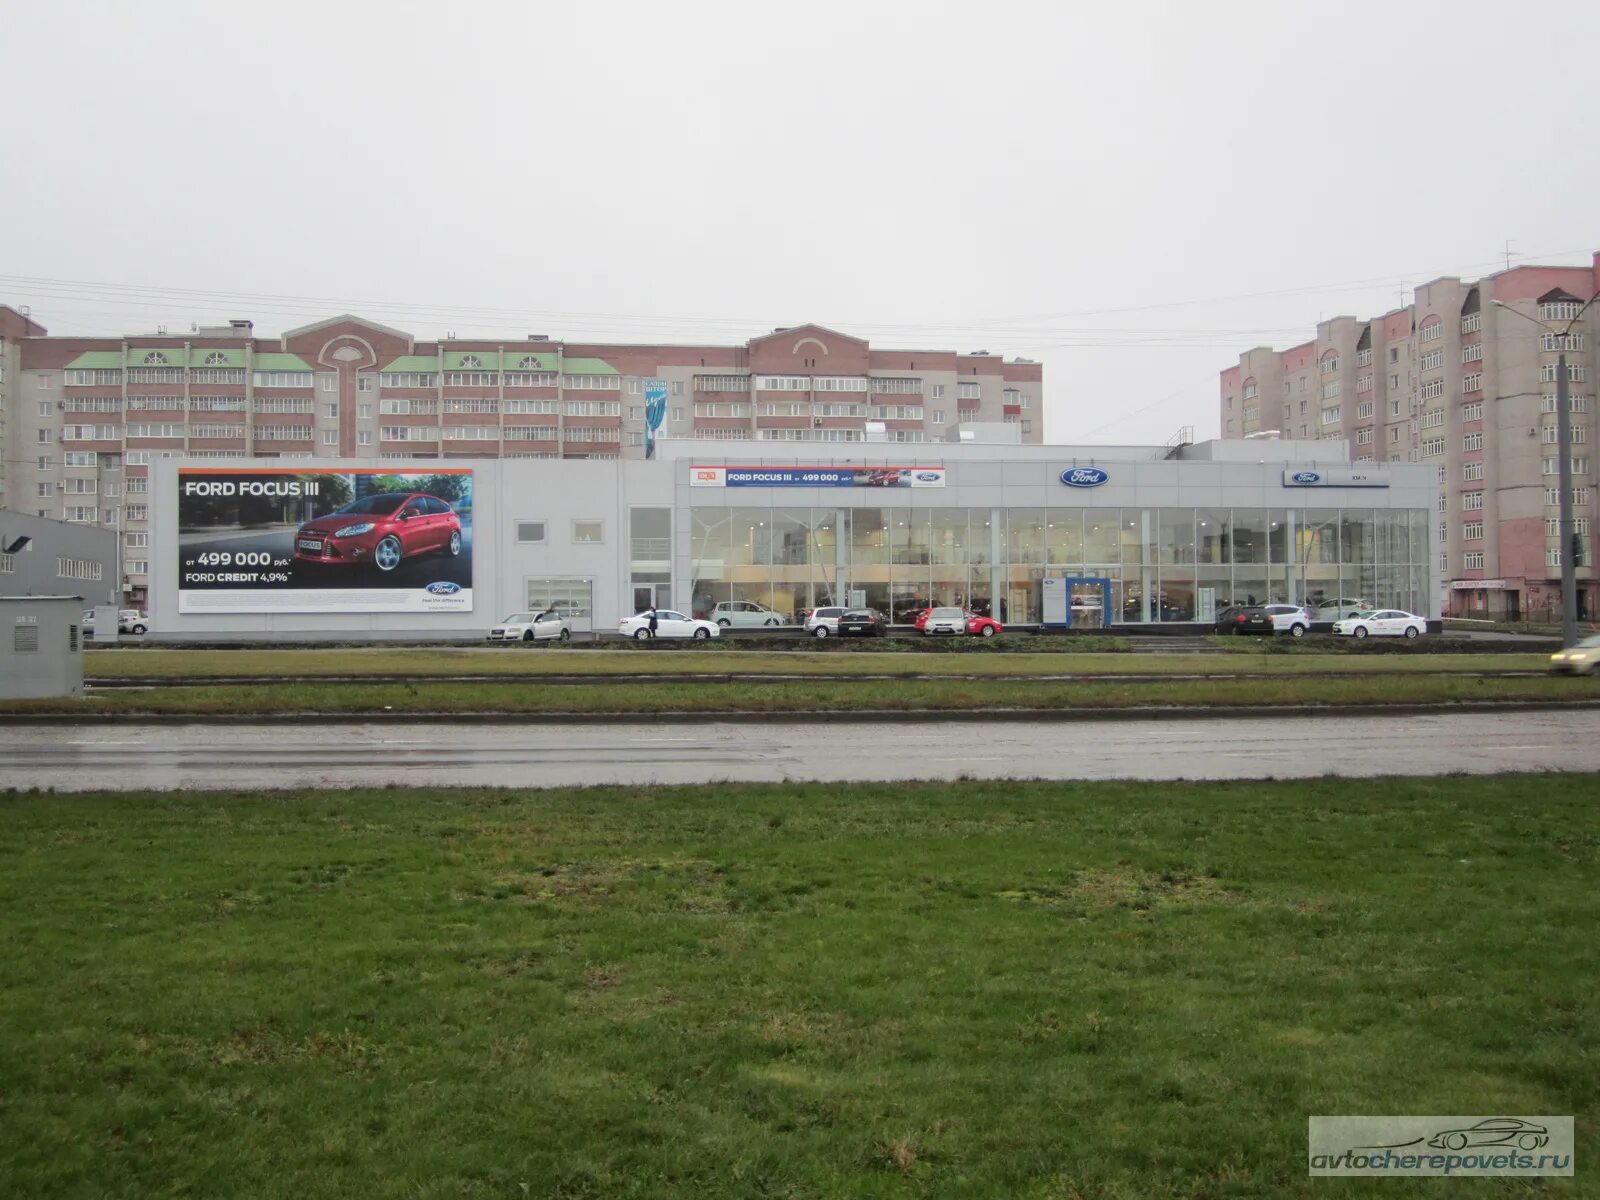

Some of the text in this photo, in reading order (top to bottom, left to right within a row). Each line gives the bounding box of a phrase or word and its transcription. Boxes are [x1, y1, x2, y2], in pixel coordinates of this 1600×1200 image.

[728, 473, 752, 481] FORD
[752, 473, 783, 481] FOCUS
[783, 473, 792, 481] III
[802, 473, 819, 481] 499
[820, 473, 838, 481] 000
[185, 482, 319, 496] FORD FOCUS III
[198, 552, 232, 566] 499
[234, 552, 271, 566] 000
[186, 573, 215, 582] FORD
[217, 573, 259, 582] CREDIT
